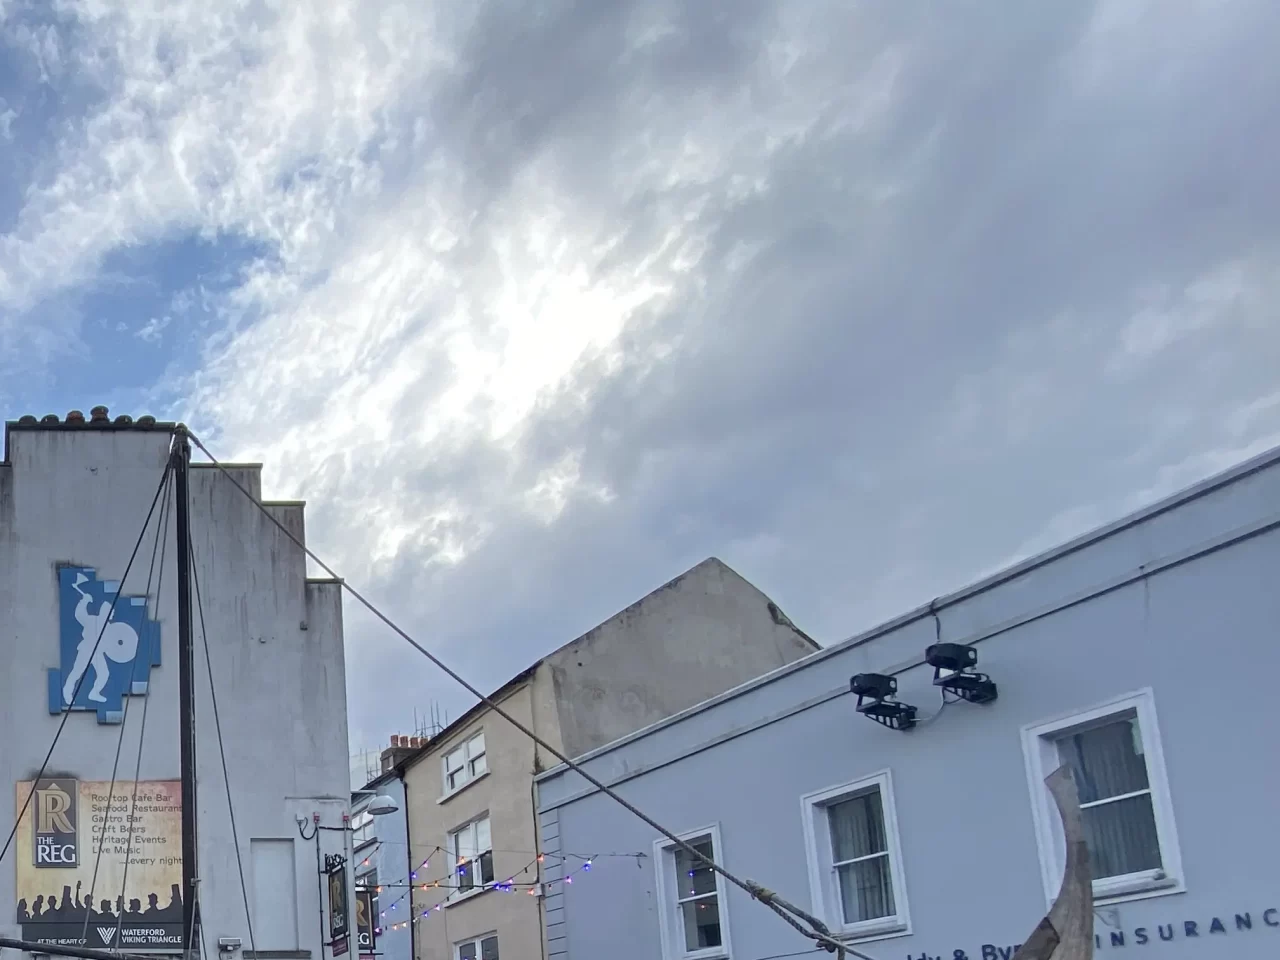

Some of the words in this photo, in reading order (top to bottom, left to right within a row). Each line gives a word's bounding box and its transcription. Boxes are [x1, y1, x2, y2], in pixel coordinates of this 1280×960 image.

[91, 793, 129, 804] Rootop
[131, 793, 154, 802] Cafe
[155, 793, 173, 802] Bar
[133, 804, 182, 812] Restaurant
[126, 814, 143, 823] Bar
[37, 836, 55, 845] THE
[135, 835, 167, 843] Events
[37, 844, 76, 863] REG
[92, 846, 111, 854] Lve
[114, 846, 141, 854] Music
[159, 855, 183, 866] night
[121, 928, 166, 937] WATERFORD
[148, 936, 182, 944] TRIANGLE
